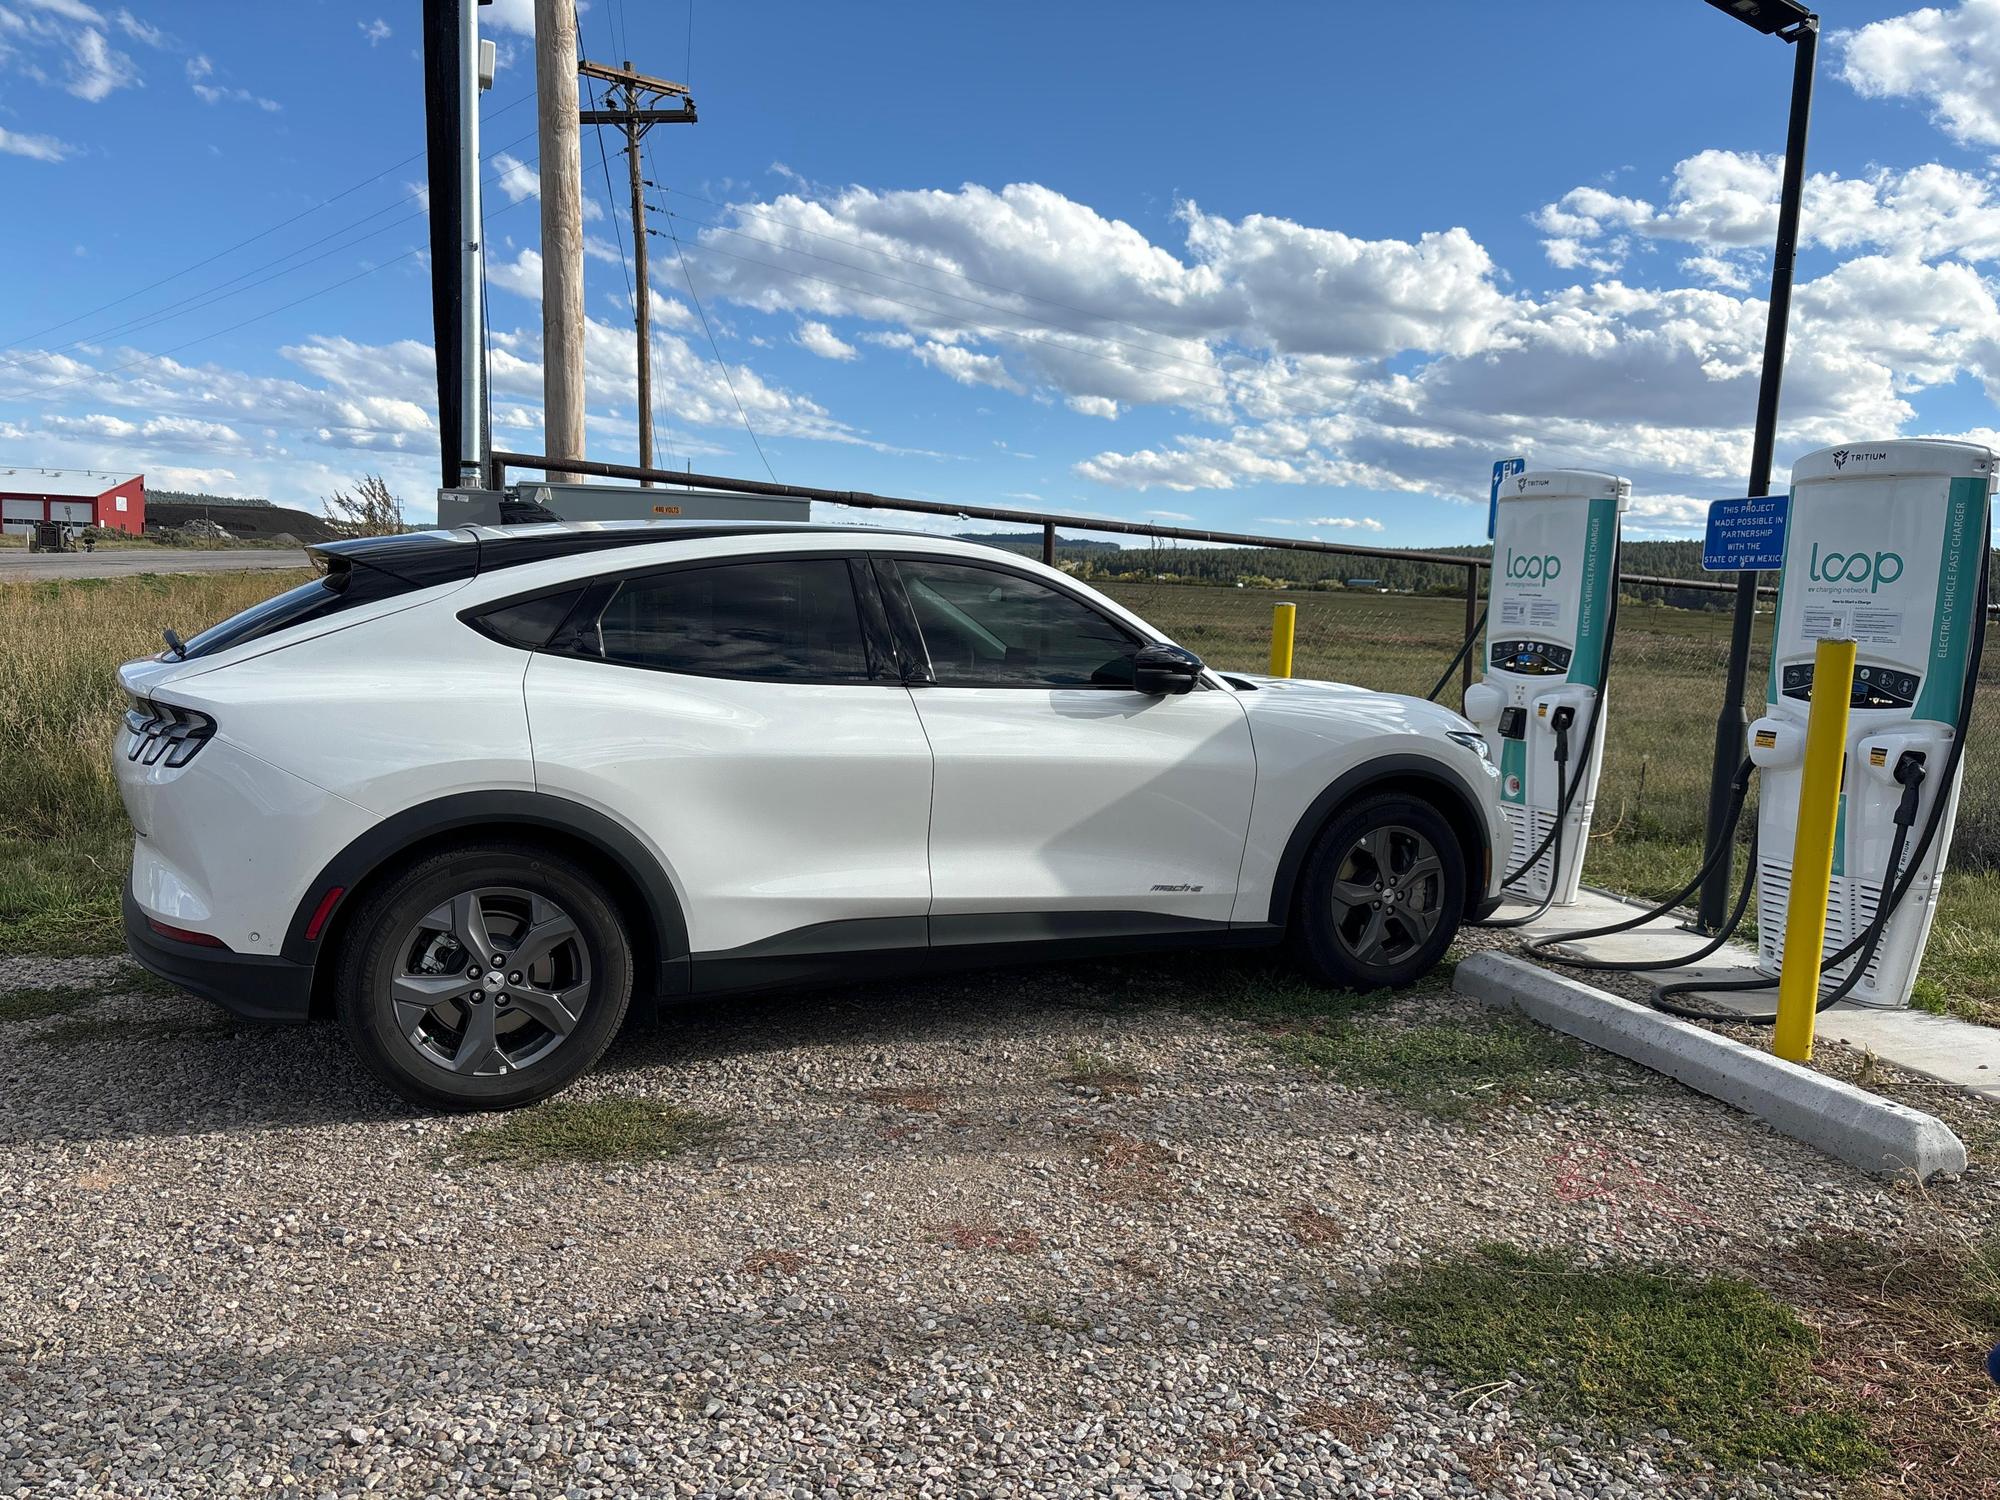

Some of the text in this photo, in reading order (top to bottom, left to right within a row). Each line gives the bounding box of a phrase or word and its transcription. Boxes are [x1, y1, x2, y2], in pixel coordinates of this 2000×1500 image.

[1850, 452, 1887, 462] TRITIUM
[1723, 504, 1775, 514] THIS PROJECT
[1714, 516, 1784, 527] MADE POSSIBLE IN
[1721, 529, 1773, 538] PARTNERSHIP
[1727, 542, 1761, 551] WITH THE
[1704, 555, 1726, 563] STATE
[1728, 555, 1738, 563] OF
[1740, 555, 1755, 563] NEW
[1506, 547, 1561, 588] loop
[1809, 542, 1904, 594] loop
[1581, 518, 1600, 637] ELECTRIC VEHICLE FAST CHARGER
[1937, 502, 1966, 658] ELECTRIC VEHICLE FAST CHARGER
[1816, 586, 1842, 594] charging
[1900, 841, 1911, 866] TRITIUM
